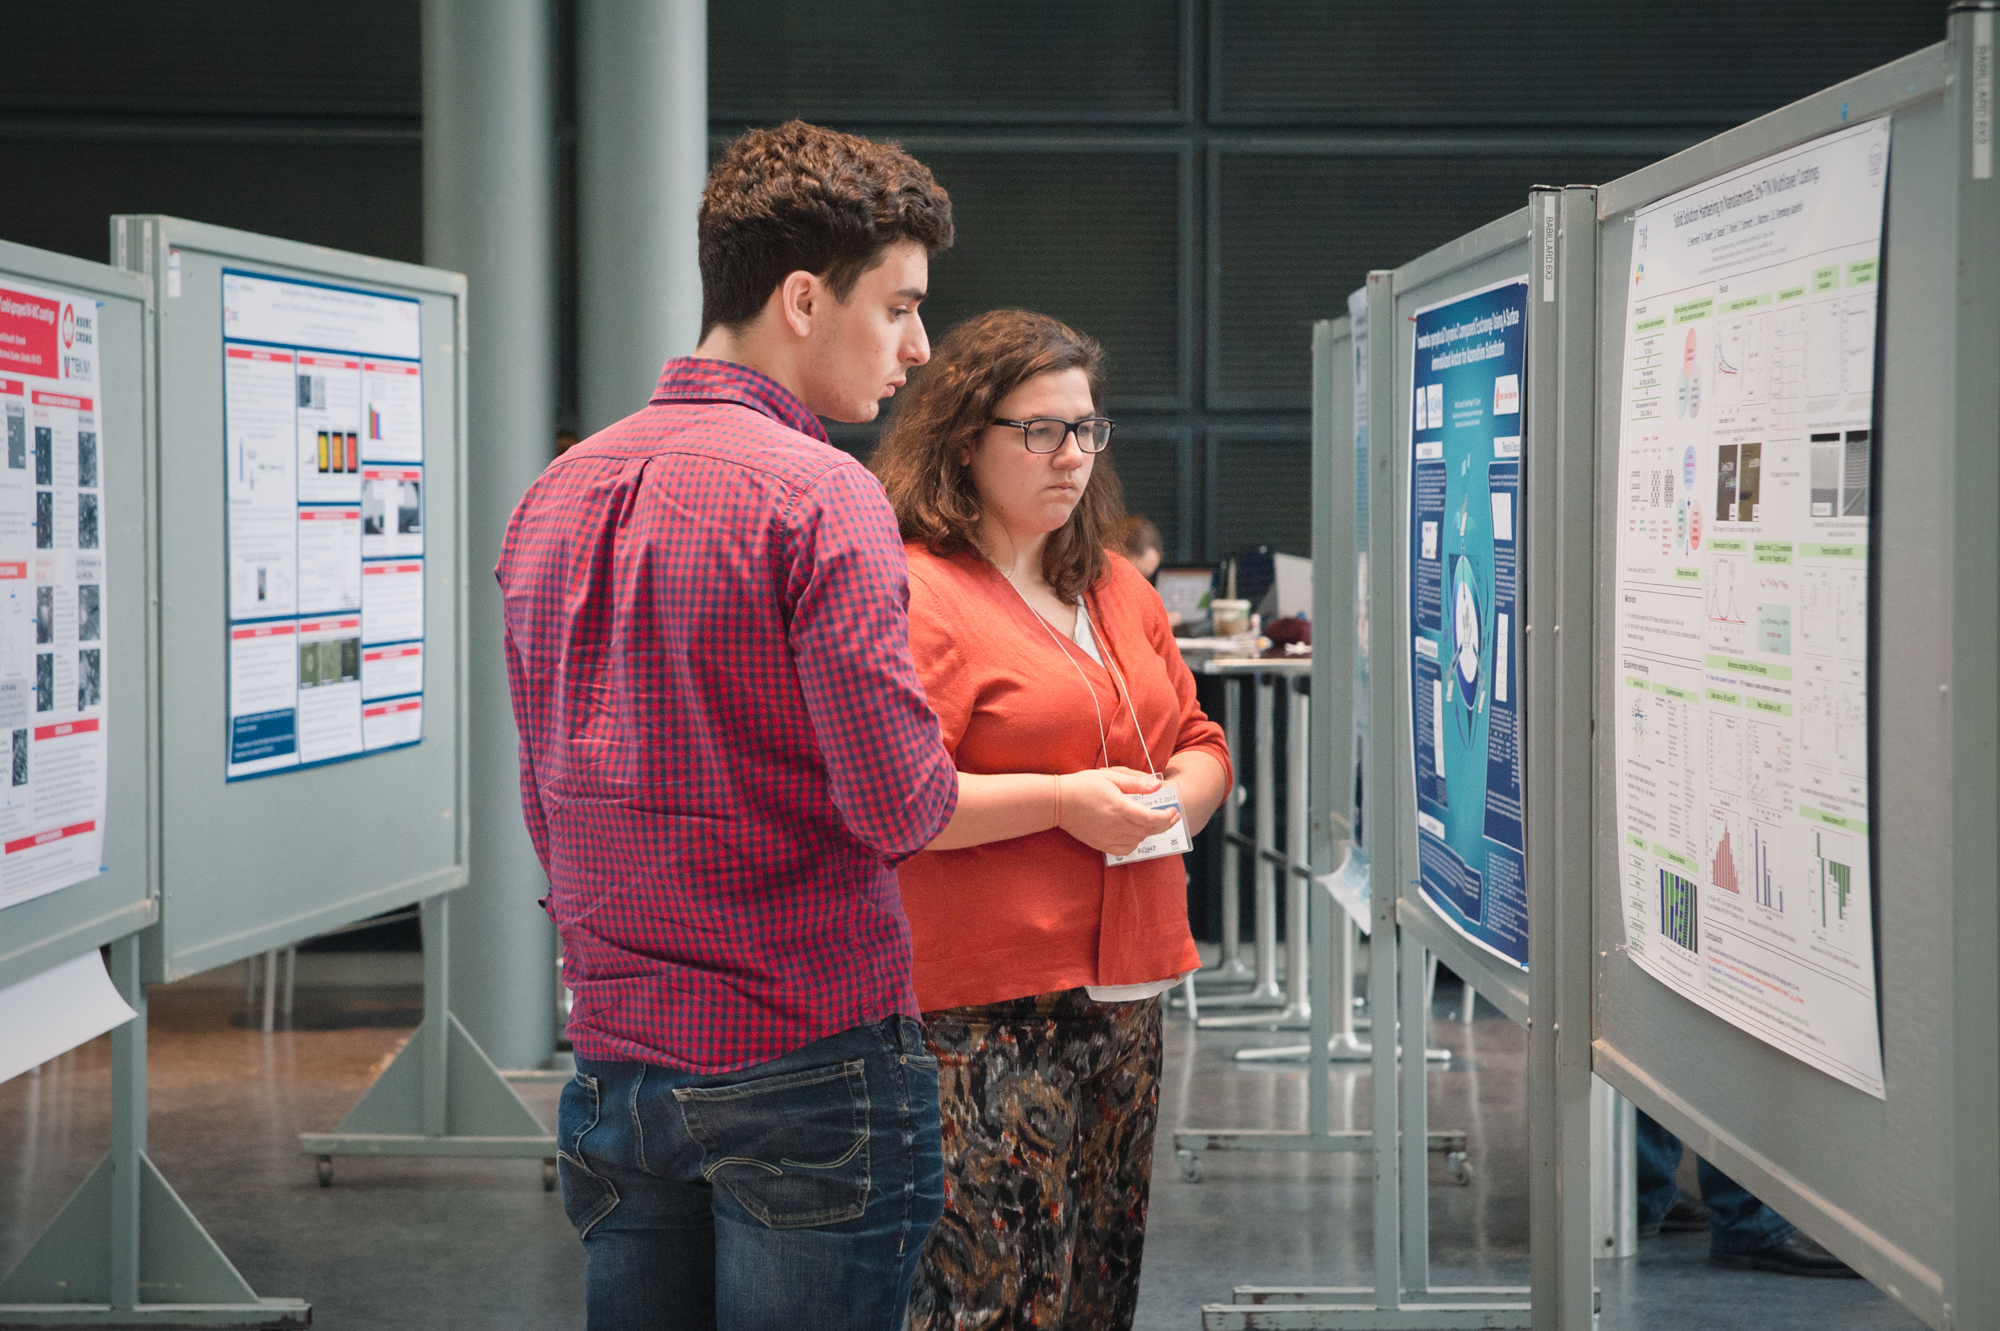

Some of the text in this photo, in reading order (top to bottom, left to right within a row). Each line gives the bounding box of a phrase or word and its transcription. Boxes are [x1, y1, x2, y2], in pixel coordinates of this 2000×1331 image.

[1698, 199, 1720, 218] Hardening
[1545, 216, 1554, 280] BABILLARD 6X3
[76, 316, 92, 329] NSERC
[1475, 315, 1493, 336] Exchange
[1491, 311, 1504, 333] Using
[1506, 306, 1519, 327] Surface
[76, 331, 92, 345] CRSNG
[1164, 795, 1176, 803] 2017
[1137, 845, 1157, 854] RQMP
